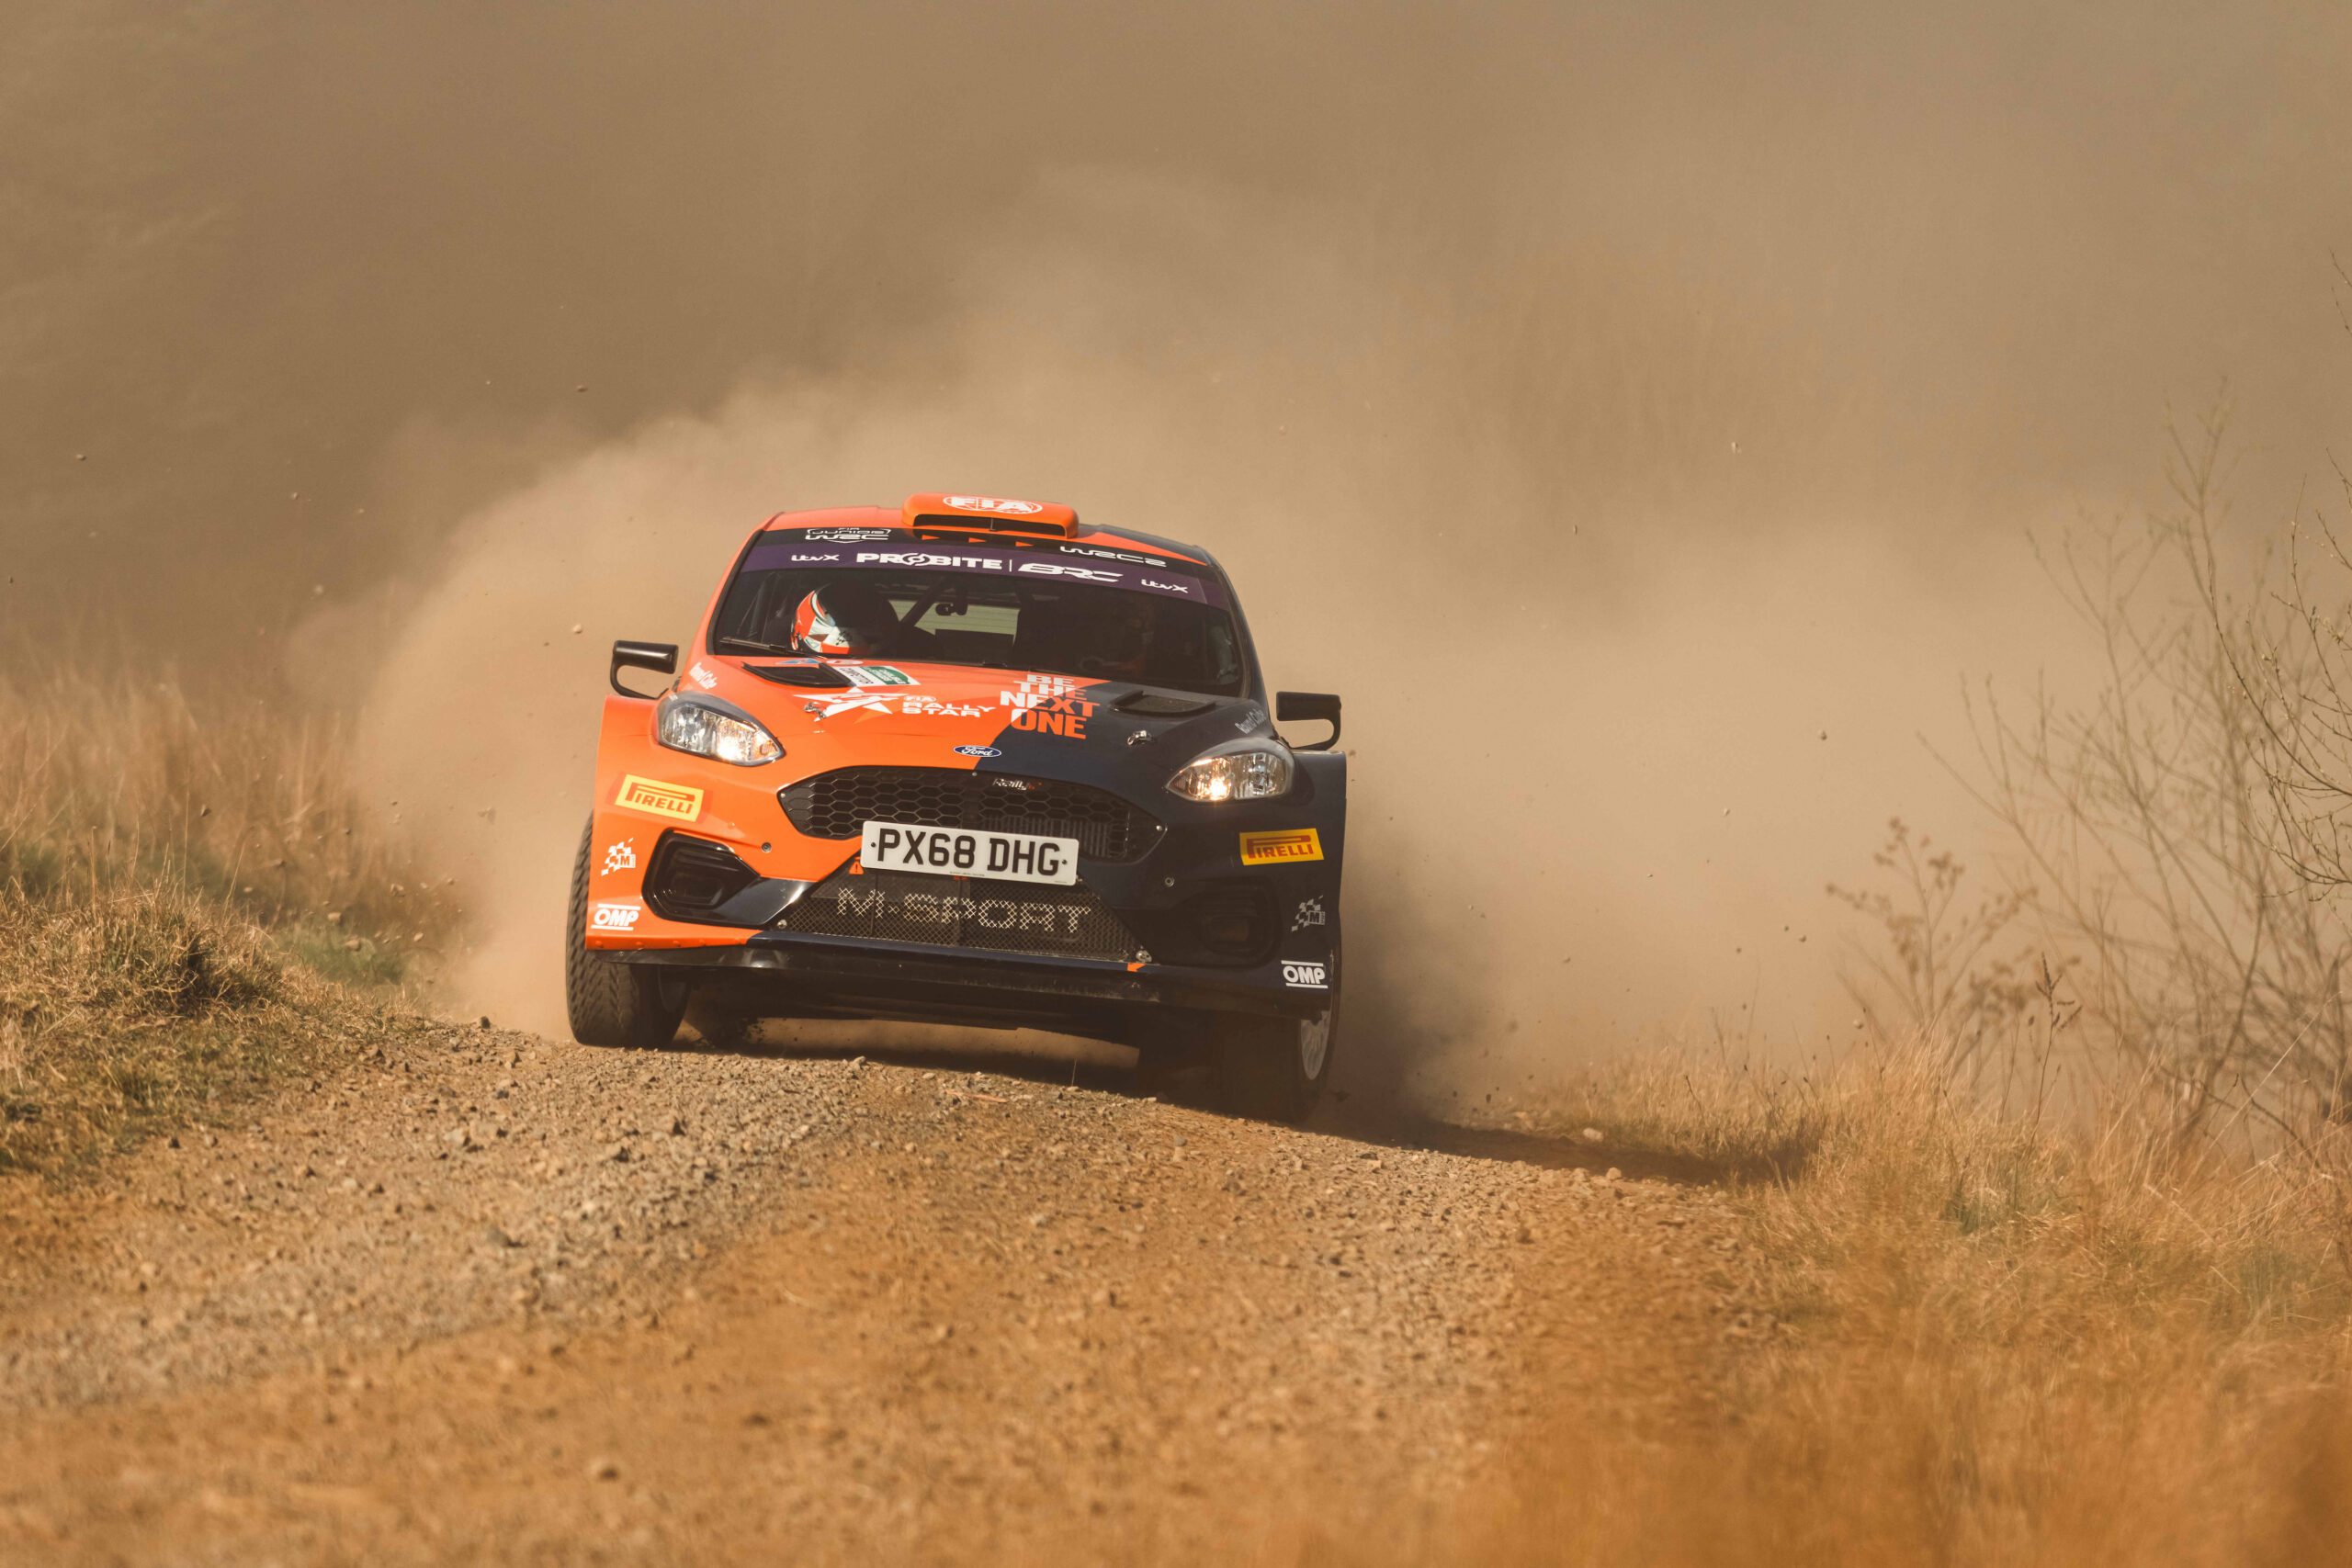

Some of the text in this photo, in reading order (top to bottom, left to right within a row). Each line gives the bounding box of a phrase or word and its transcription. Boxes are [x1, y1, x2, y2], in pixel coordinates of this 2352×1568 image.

[950, 496, 1033, 513] FIA
[856, 552, 1124, 582] PROBITE BRC
[1059, 546, 1167, 568] WRC2
[1026, 673, 1075, 685] BE
[1012, 680, 1088, 701] THE
[901, 707, 981, 717] STAR
[902, 702, 997, 713] RALLY
[999, 690, 1101, 717] NEXT
[1011, 708, 1087, 740] ONE
[961, 745, 994, 756] Ford
[625, 781, 695, 815] PIRELLI
[876, 828, 1060, 876] PX68 DHG
[1247, 834, 1314, 859] PIRELLI
[594, 908, 639, 927] OMP
[1283, 964, 1326, 985] OMP
